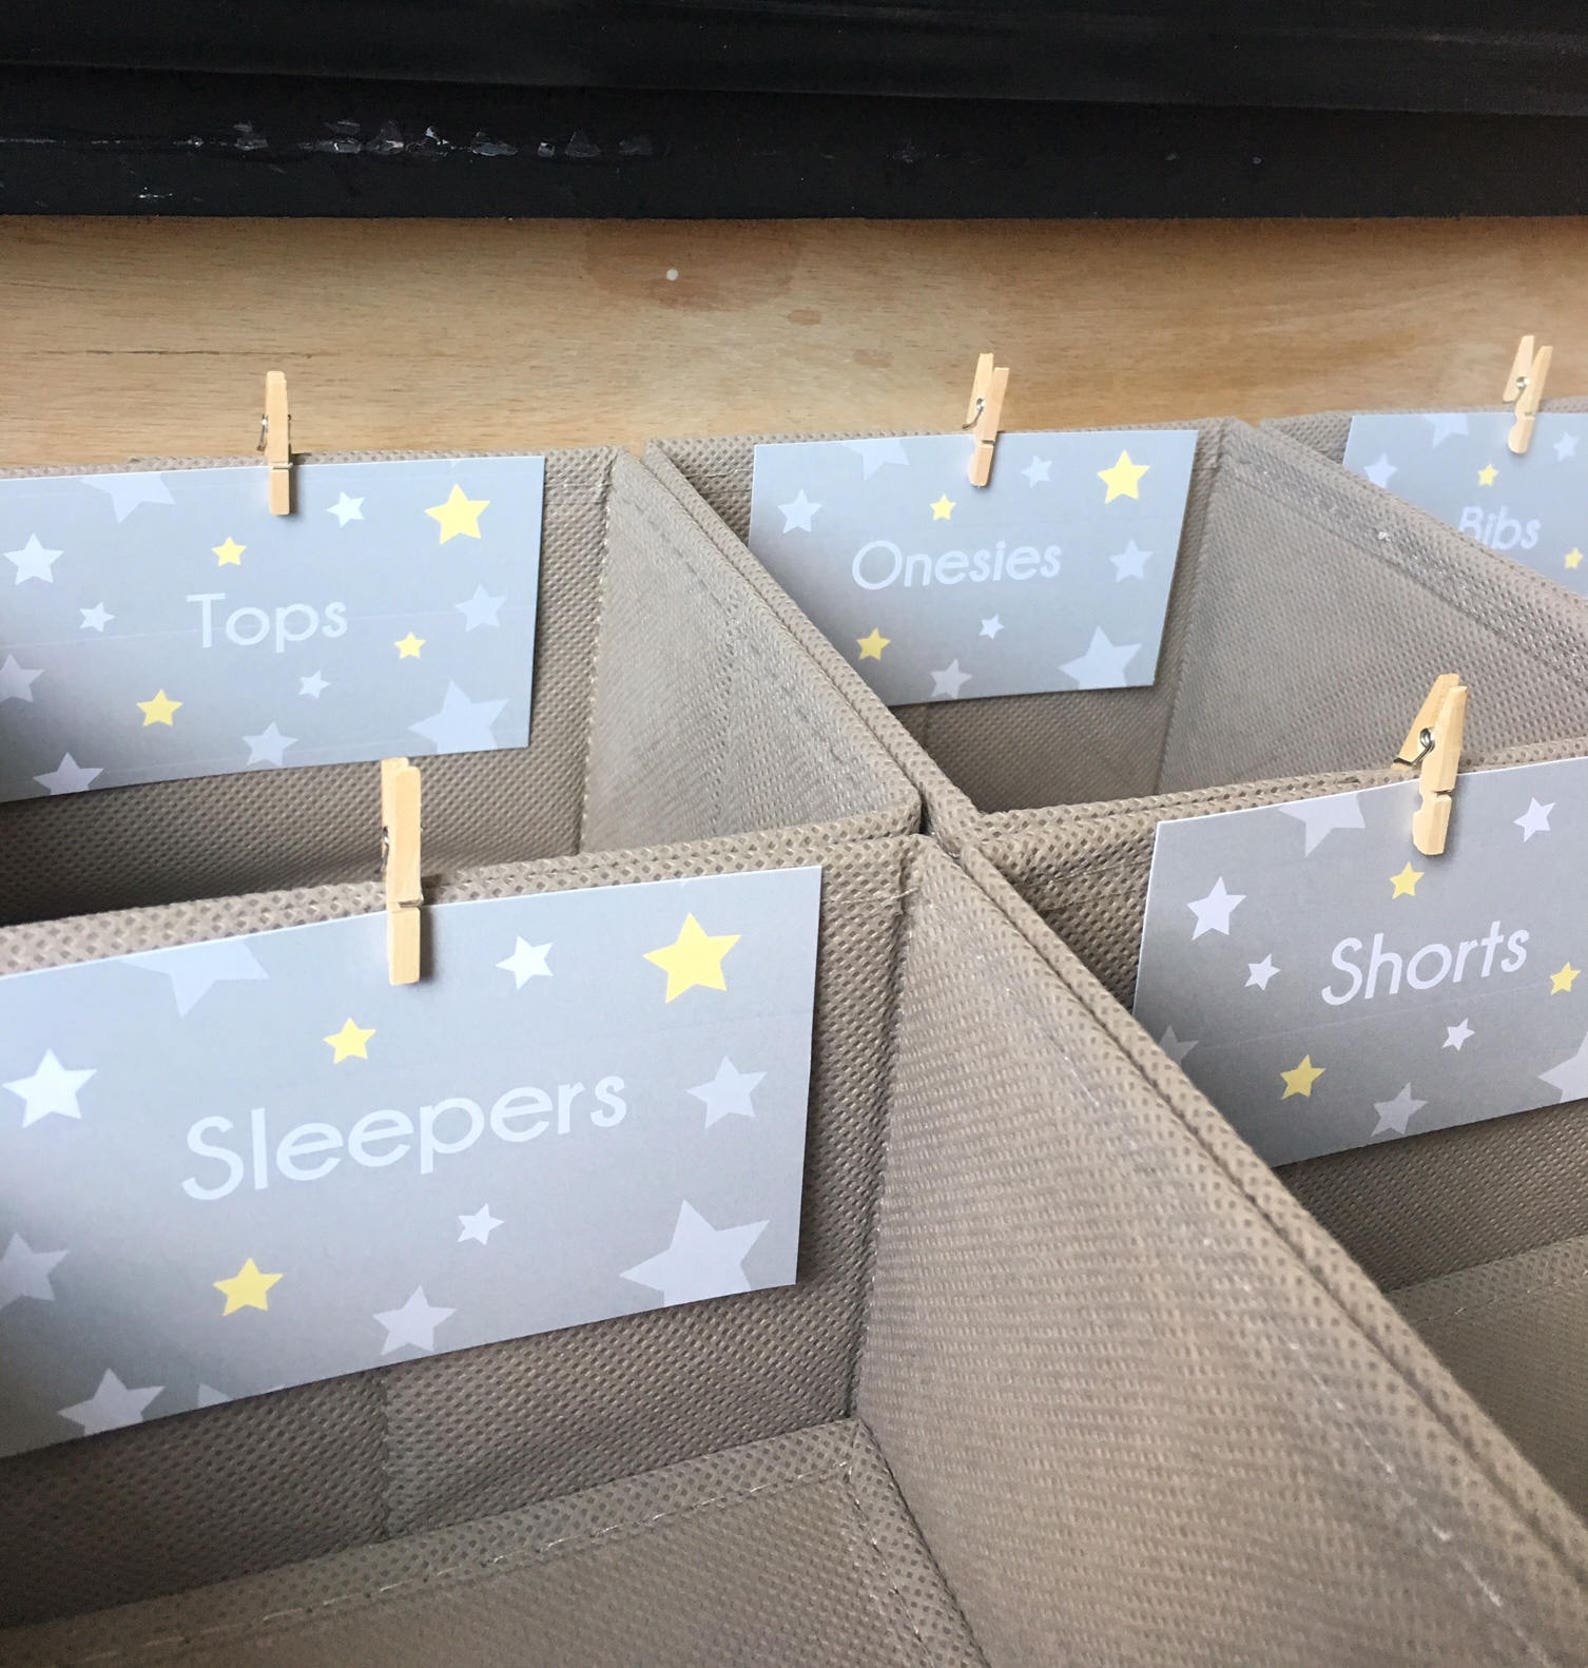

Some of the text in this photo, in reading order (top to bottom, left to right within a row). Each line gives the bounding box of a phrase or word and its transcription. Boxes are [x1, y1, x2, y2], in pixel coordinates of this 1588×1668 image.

[851, 539, 1063, 590] Onesies
[186, 592, 348, 653] Tops
[1320, 920, 1530, 1007] Shorts
[181, 1074, 628, 1201] Sleepers
